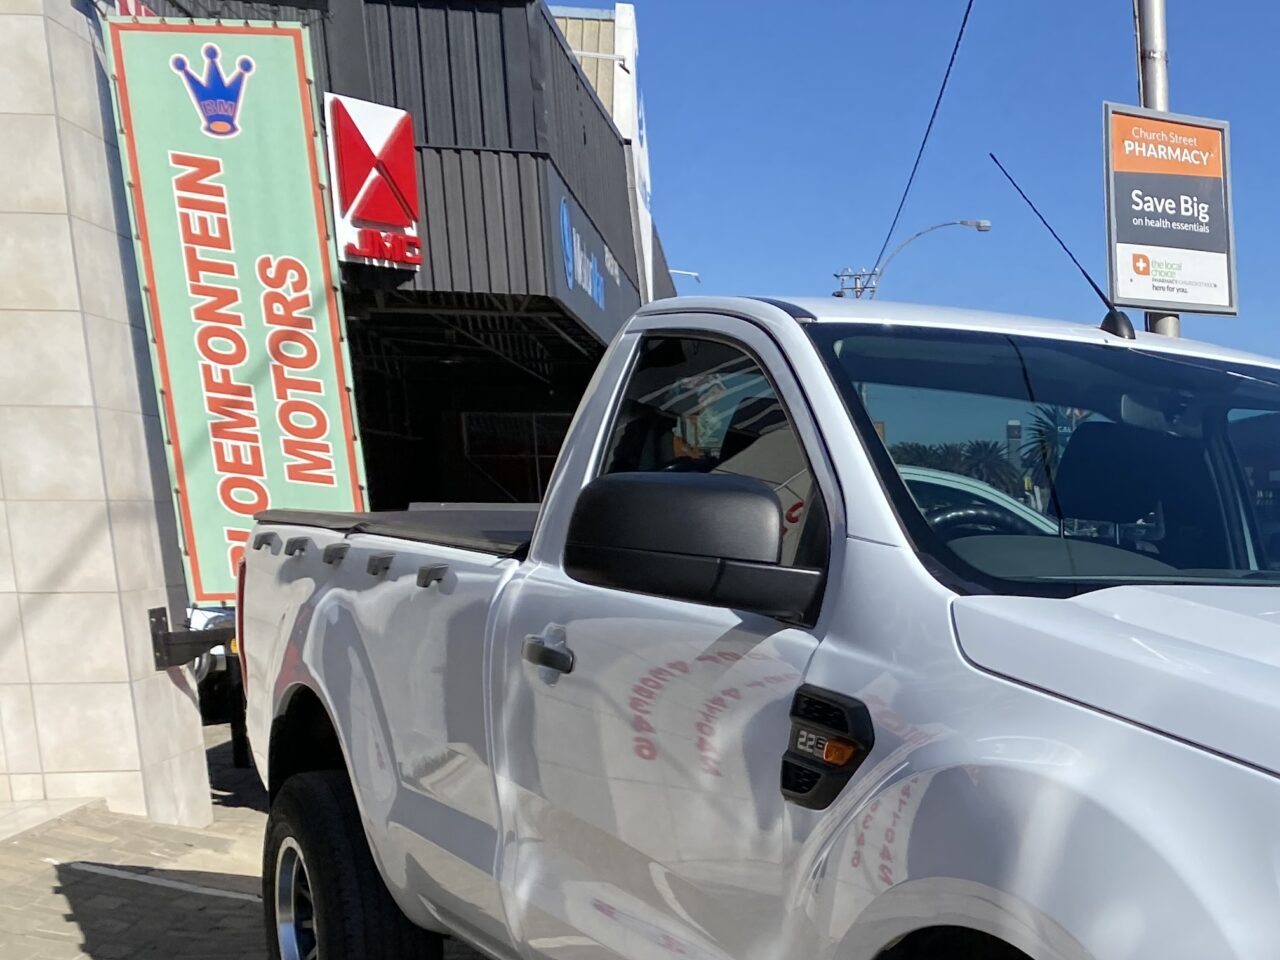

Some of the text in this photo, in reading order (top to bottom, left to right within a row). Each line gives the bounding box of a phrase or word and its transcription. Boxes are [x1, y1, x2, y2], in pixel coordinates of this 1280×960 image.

[200, 99, 235, 116] BM
[1131, 126, 1198, 147] Church Street
[1124, 140, 1210, 166] PHARMACY
[1131, 189, 1210, 223] Save Big
[1132, 217, 1210, 233] on health essentials
[344, 228, 423, 265] JMC
[1151, 259, 1183, 271] the local
[1151, 268, 1177, 278] choice
[1152, 284, 1166, 293] here
[1166, 285, 1176, 294] for
[168, 150, 271, 579] OEMFONTEIN
[257, 256, 338, 487] MOTORS
